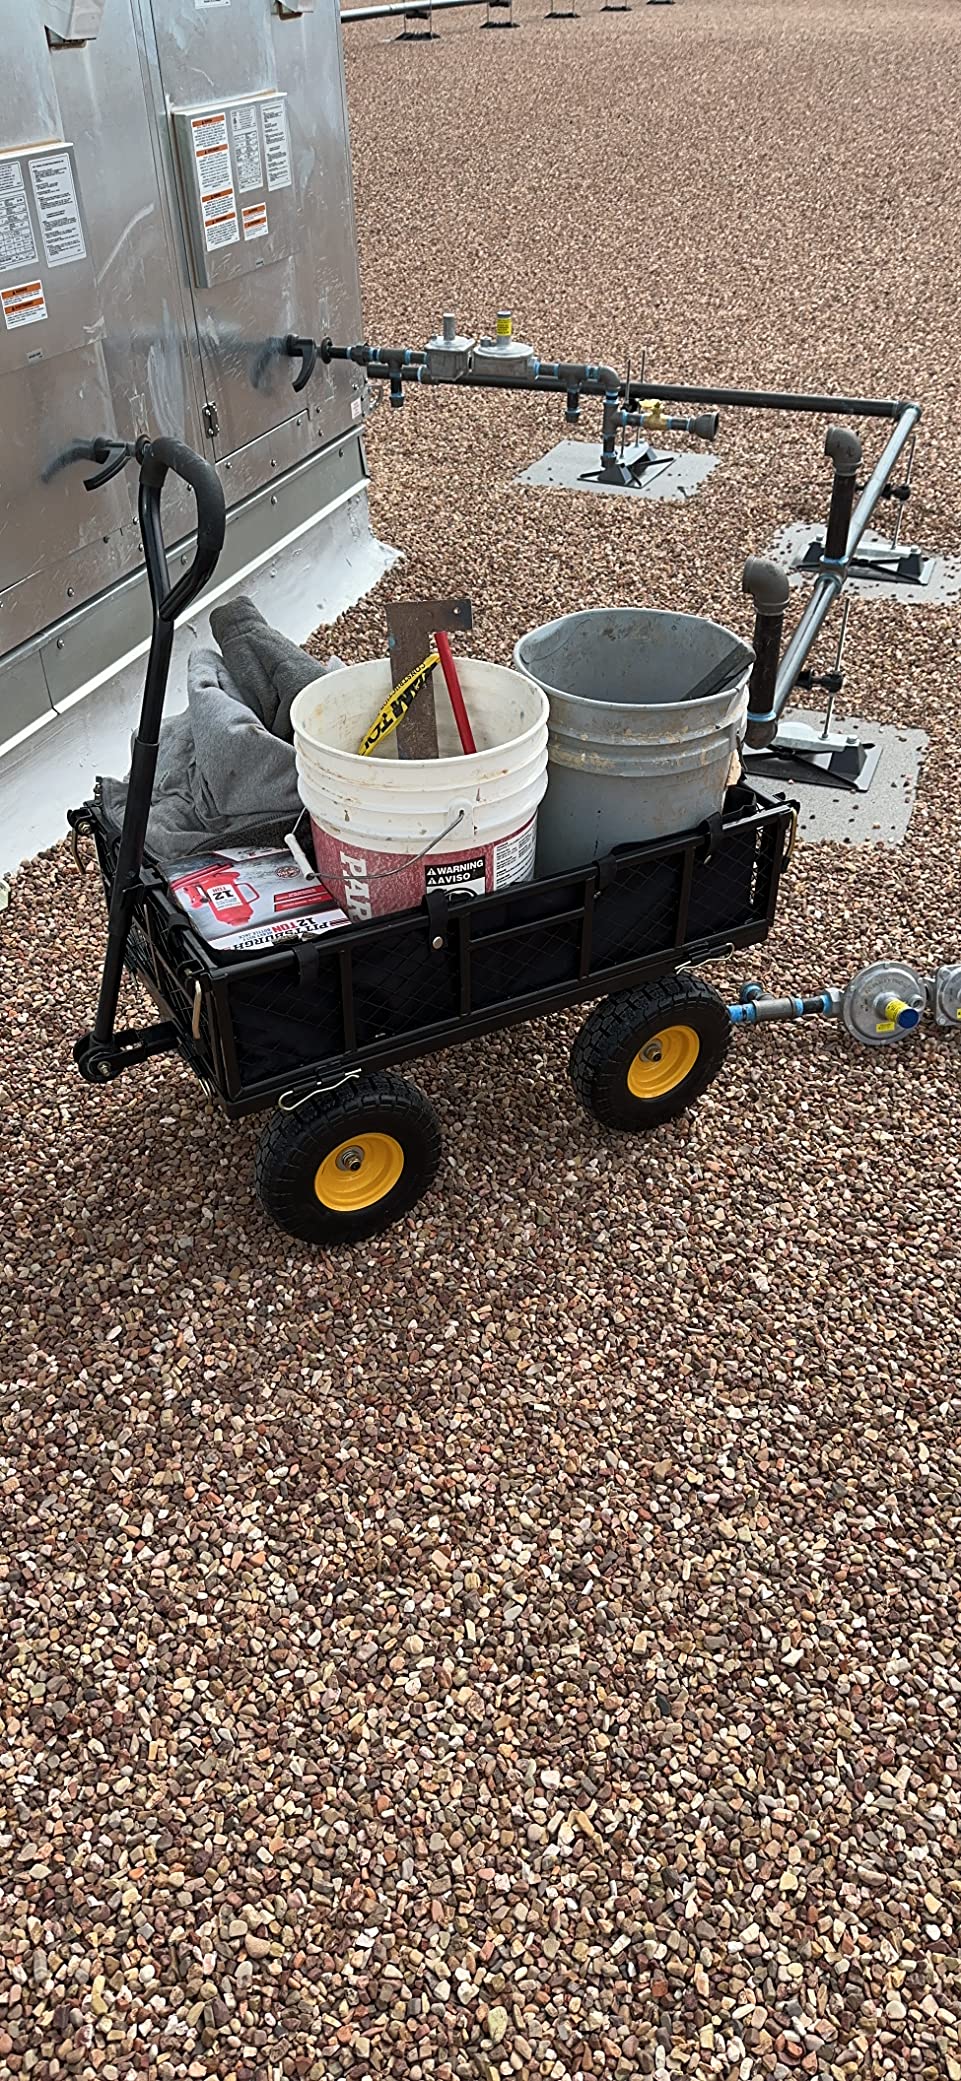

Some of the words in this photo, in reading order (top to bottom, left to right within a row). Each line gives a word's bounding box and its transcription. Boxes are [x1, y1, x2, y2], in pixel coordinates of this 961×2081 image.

[437, 860, 484, 875] WARNING
[437, 873, 471, 885] AVISO
[212, 889, 235, 901] 12
[271, 920, 298, 933] TON
[297, 916, 316, 927] 12
